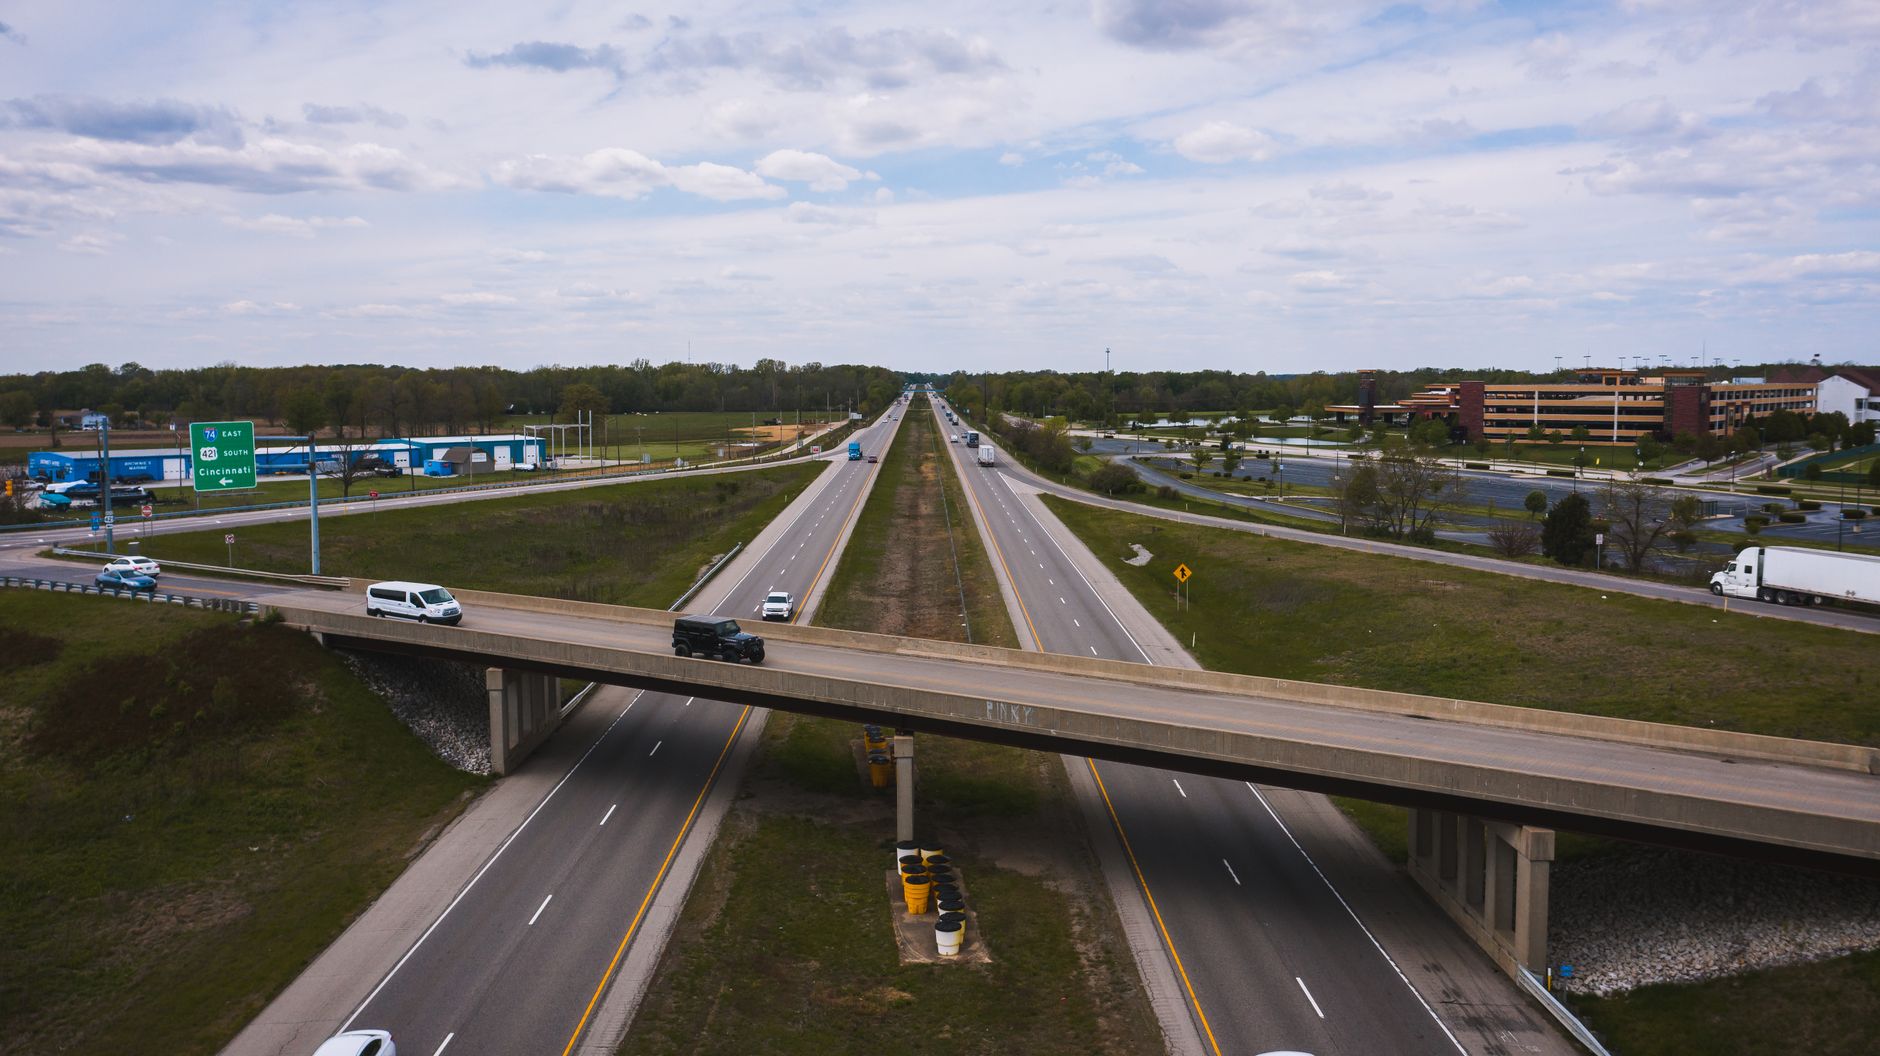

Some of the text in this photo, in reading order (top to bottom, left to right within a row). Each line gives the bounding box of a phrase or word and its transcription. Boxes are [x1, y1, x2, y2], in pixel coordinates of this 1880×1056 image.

[204, 430, 216, 439] 74
[202, 449, 249, 459] 421 SOUTH
[199, 465, 251, 476] Cincinnati
